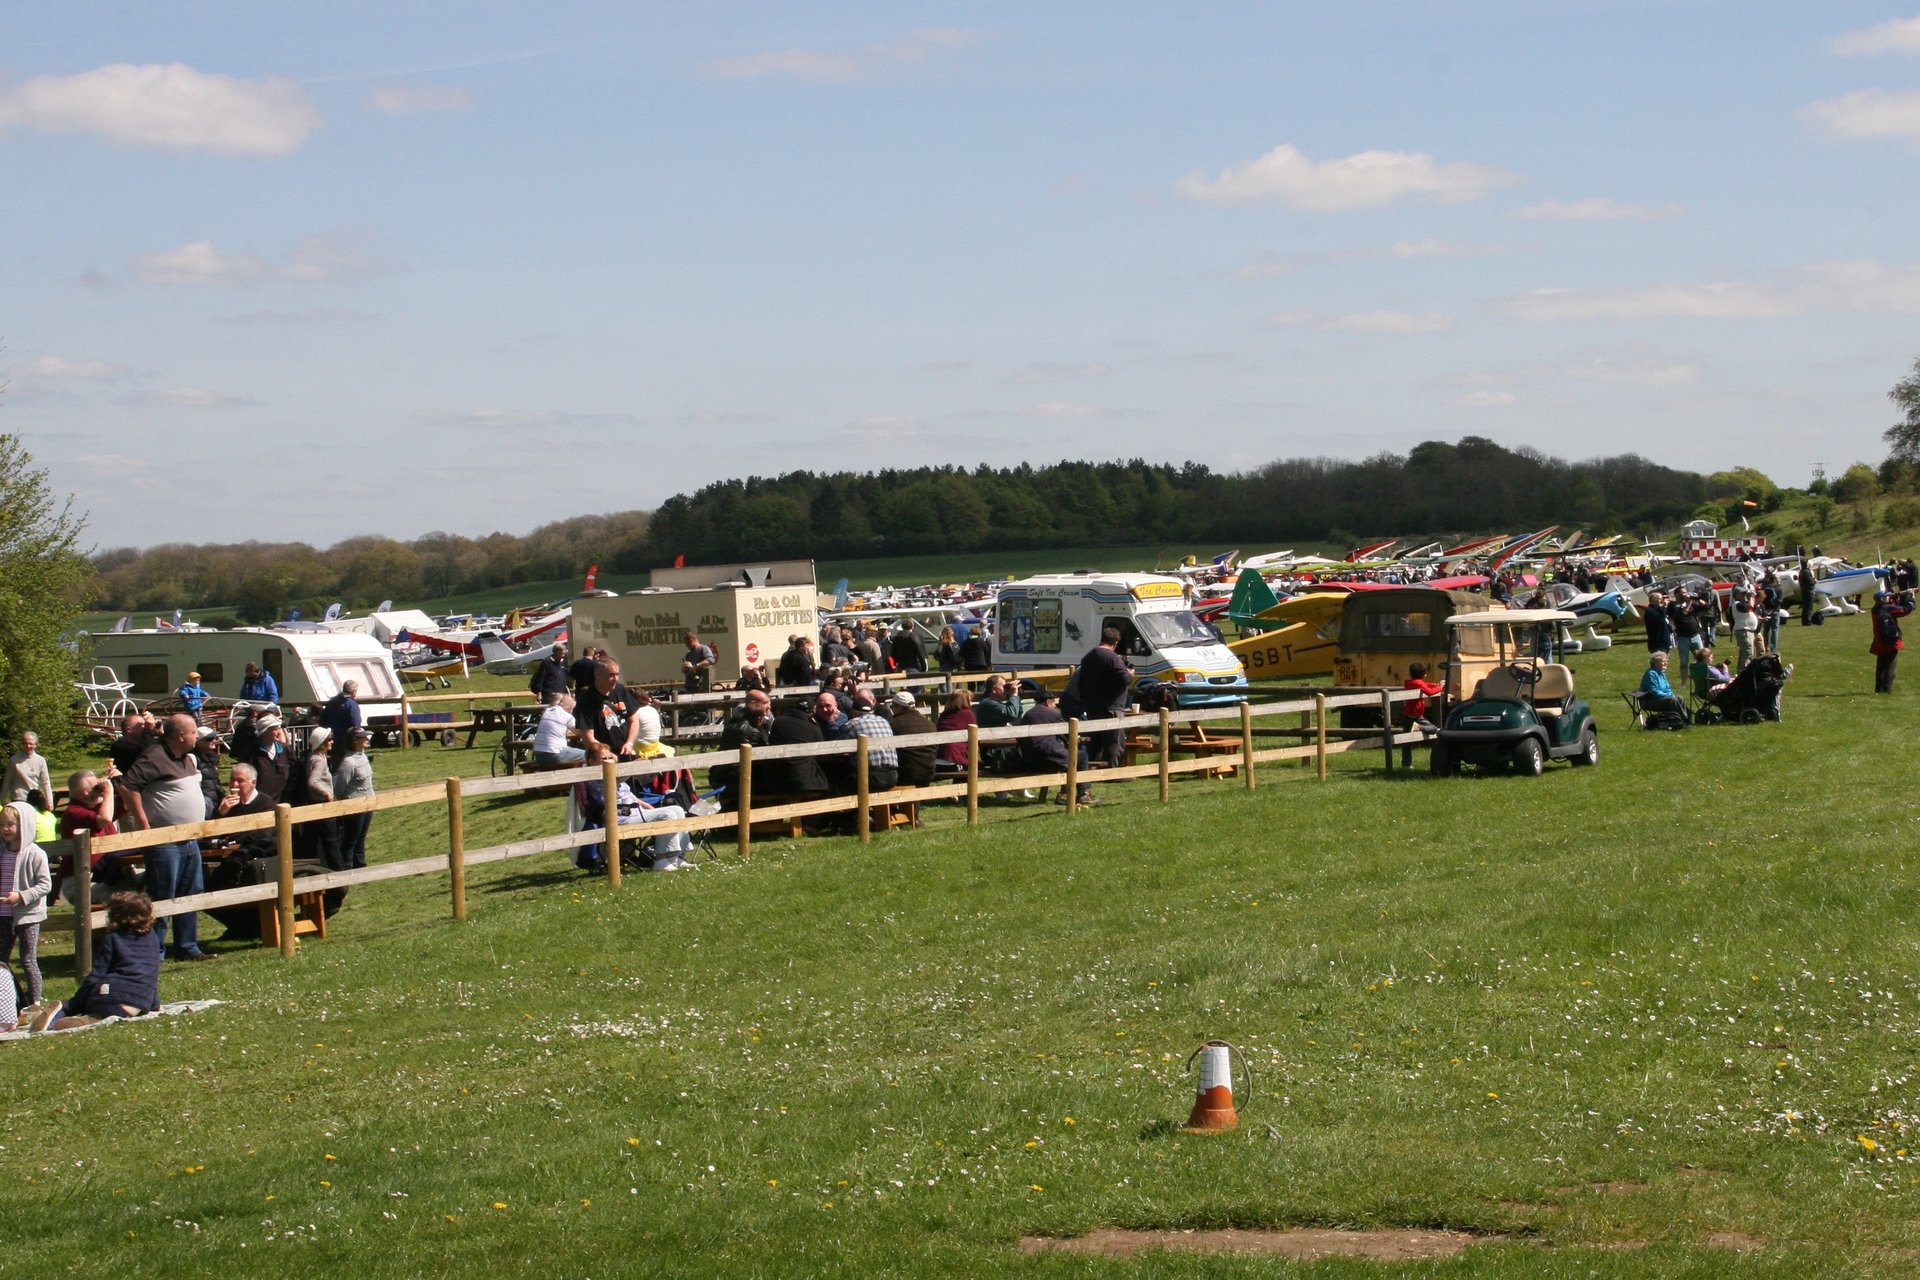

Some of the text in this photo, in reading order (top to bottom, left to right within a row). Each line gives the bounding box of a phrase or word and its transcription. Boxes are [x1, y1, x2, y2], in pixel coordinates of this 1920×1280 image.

[1029, 588, 1080, 599] Soft Ice Cream
[1140, 584, 1179, 596] Ice Cream
[754, 594, 800, 609] Hot & Cold
[701, 614, 725, 625] All Day
[743, 609, 813, 628] BAGUETTES
[626, 627, 690, 647] BAGUETTE
